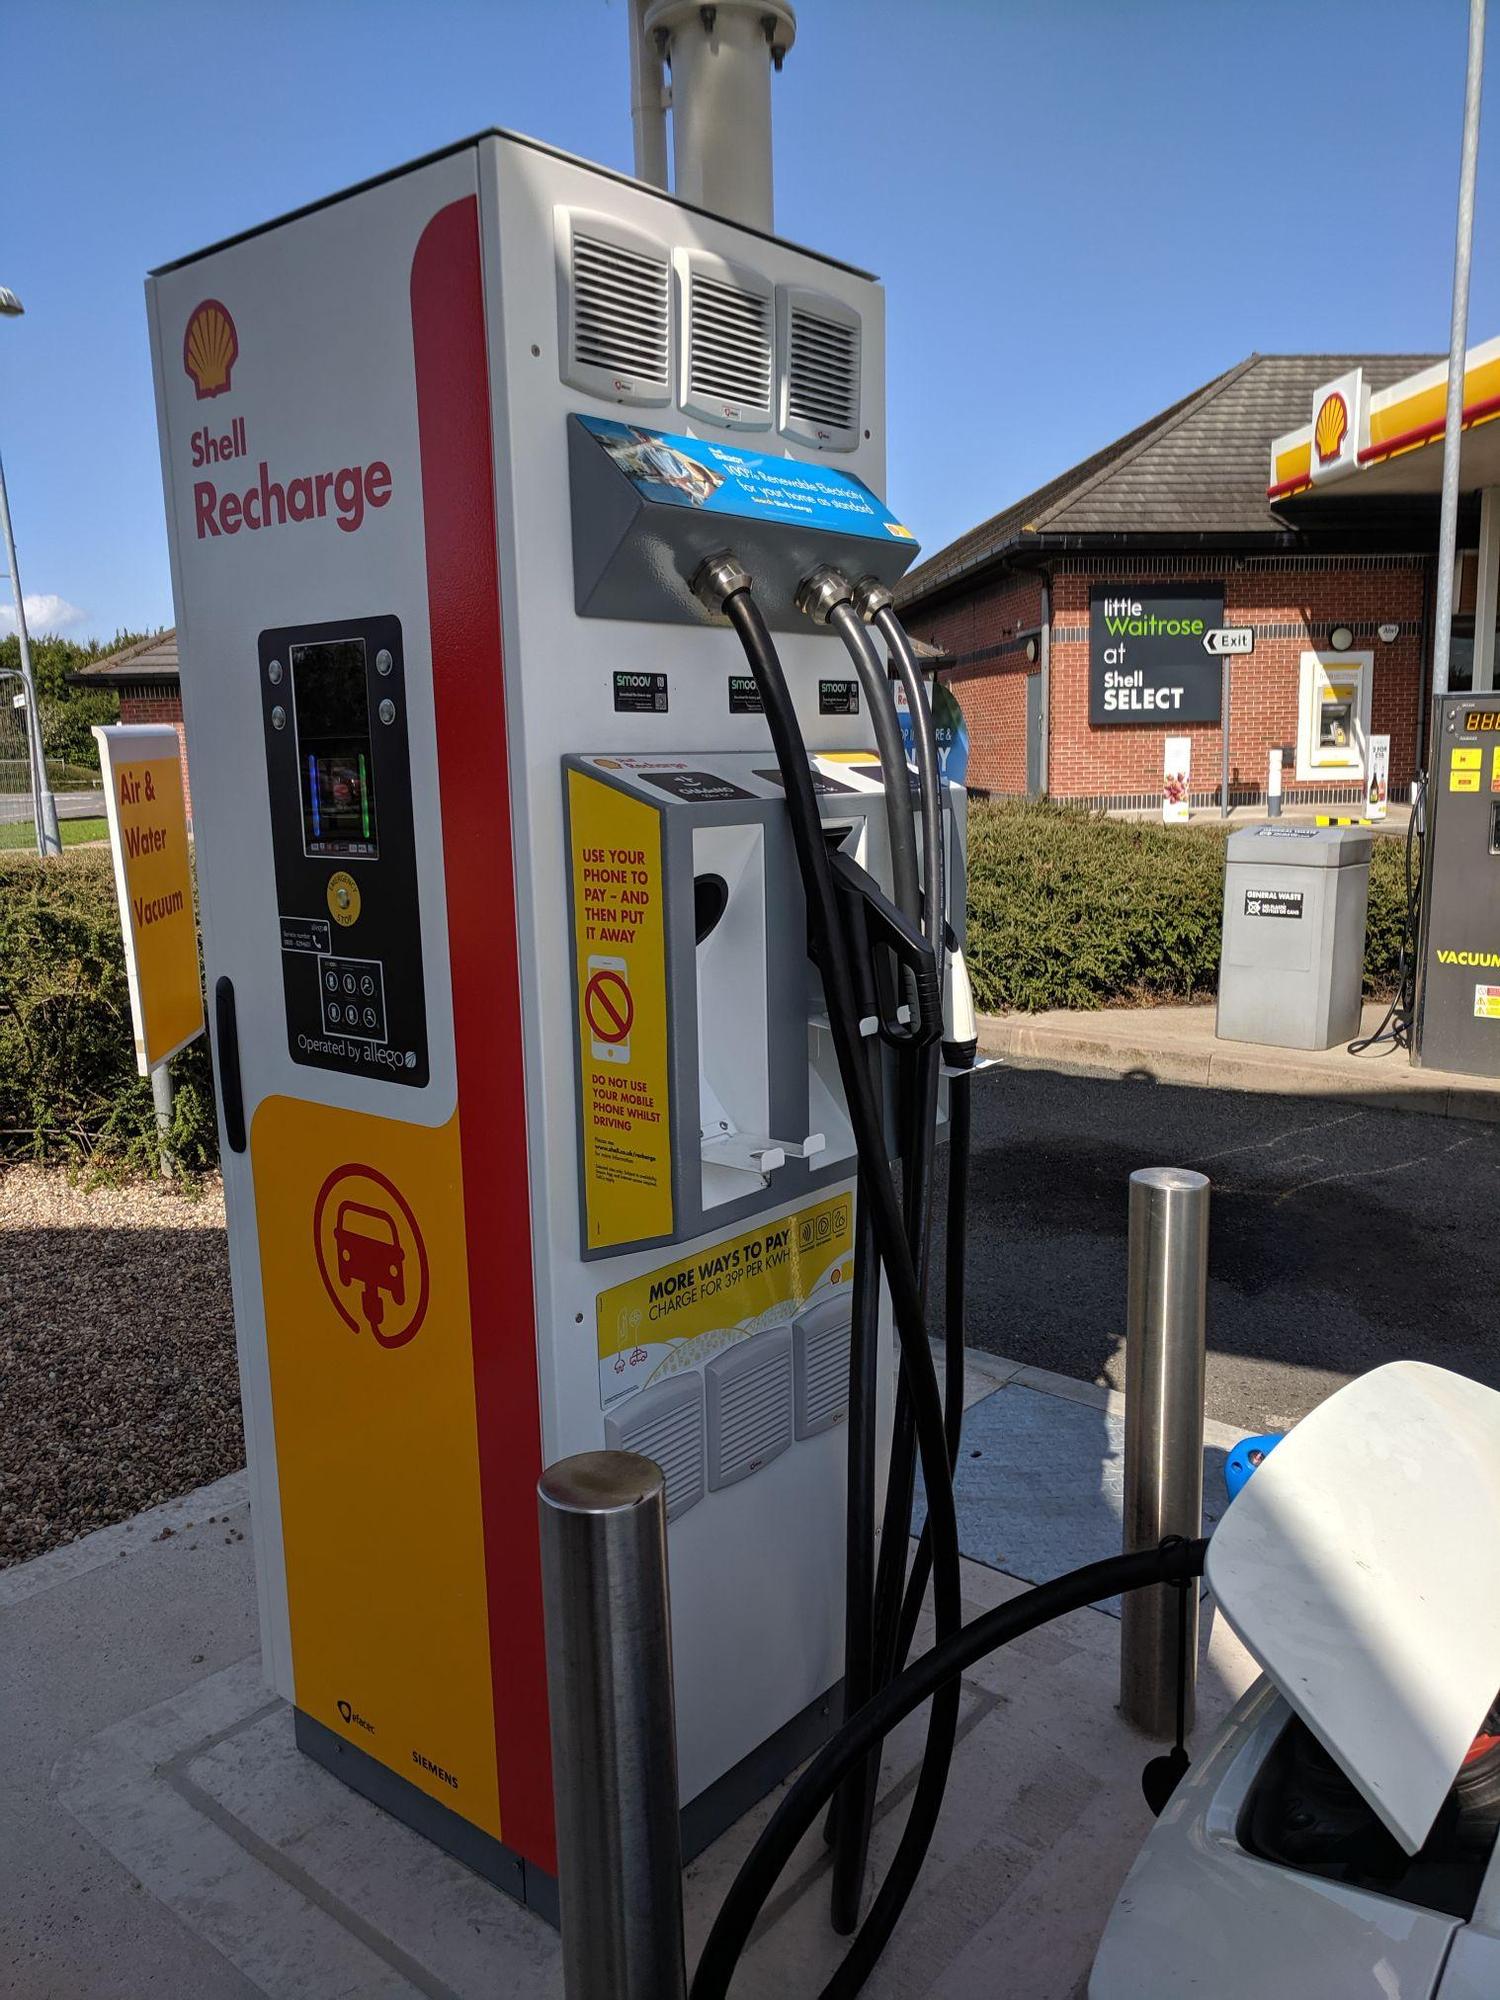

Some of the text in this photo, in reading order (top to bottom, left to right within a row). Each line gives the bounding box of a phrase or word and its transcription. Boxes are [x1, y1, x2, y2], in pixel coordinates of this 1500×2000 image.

[190, 416, 247, 468] Shell
[722, 463, 865, 504] 100% Renewable Electricity
[193, 461, 392, 539] Recharge
[735, 479, 874, 514] for your home as standard
[1103, 598, 1142, 618] little
[1105, 614, 1204, 637] Waitrose
[1220, 635, 1248, 648] Exit
[1103, 642, 1126, 664] at
[731, 679, 758, 690] smoo
[1103, 670, 1143, 688] Shell
[1103, 688, 1184, 711] SELECT
[120, 771, 155, 807] Air &
[124, 826, 167, 859] Water
[583, 849, 645, 865] USE YOUR
[329, 874, 358, 893] EMERGENCY
[584, 869, 648, 885] PHONE TO
[585, 888, 607, 902] PAY
[620, 890, 649, 905] AND
[1247, 891, 1302, 901] GENERAL WASTE
[133, 888, 183, 928] Vacuum
[585, 908, 645, 925] THEN PUT
[336, 914, 353, 925] STOP
[586, 927, 636, 943] IT AWAY
[298, 1034, 404, 1071] Operated by allego
[592, 1074, 648, 1093] DO NOT USE
[592, 1087, 654, 1108] YOUR MOBILE
[593, 1103, 661, 1123] PHONE WHILST
[593, 1115, 632, 1131] DRIVING
[648, 1272, 695, 1303] MORE
[698, 1250, 740, 1281] WAYS
[743, 1241, 763, 1263] TO
[765, 1228, 789, 1254] PAY
[648, 1250, 791, 1321] CHARGE FOR 39P PER KWH
[412, 1751, 459, 1789] SIEMENS
